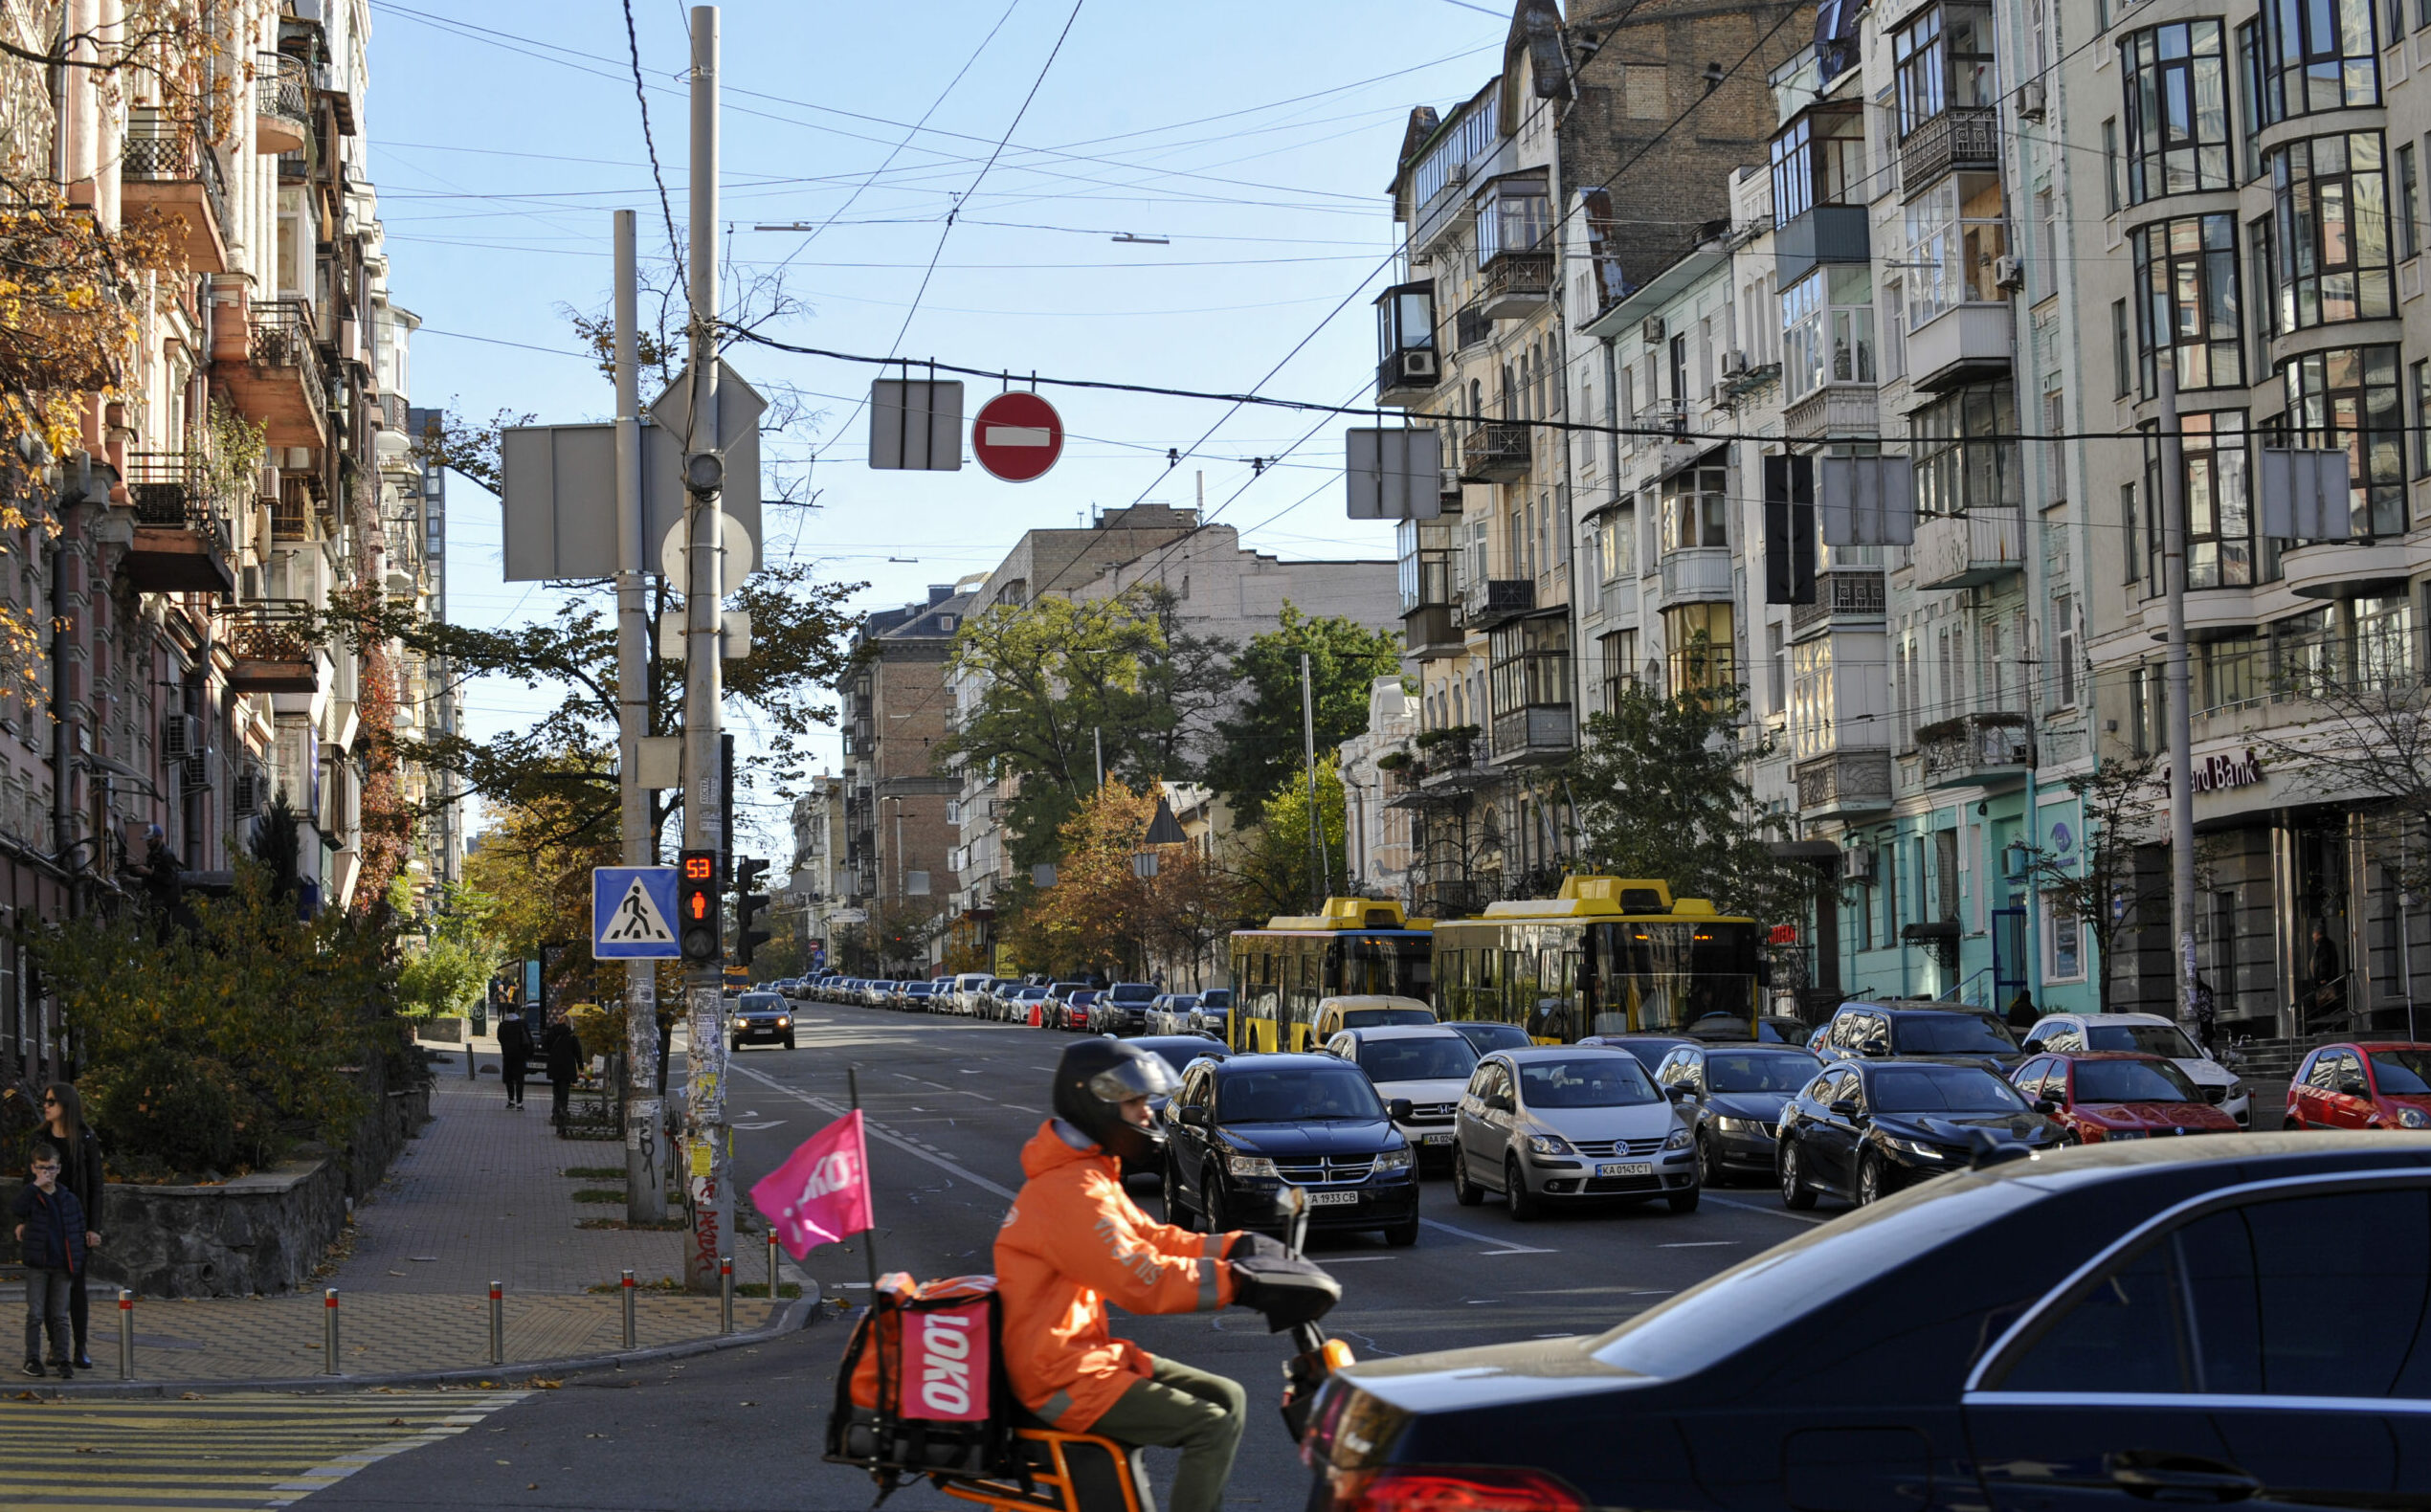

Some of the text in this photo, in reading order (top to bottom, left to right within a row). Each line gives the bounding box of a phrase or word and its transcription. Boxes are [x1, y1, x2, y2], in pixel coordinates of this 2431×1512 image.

[2214, 754, 2257, 789] Bank
[686, 857, 711, 878] 53
[1602, 1167, 1615, 1175] KA
[1617, 1165, 1636, 1174] 0143
[1320, 1193, 1341, 1204] 1933
[1342, 1192, 1356, 1202] CB
[922, 1313, 970, 1415] LOKO
